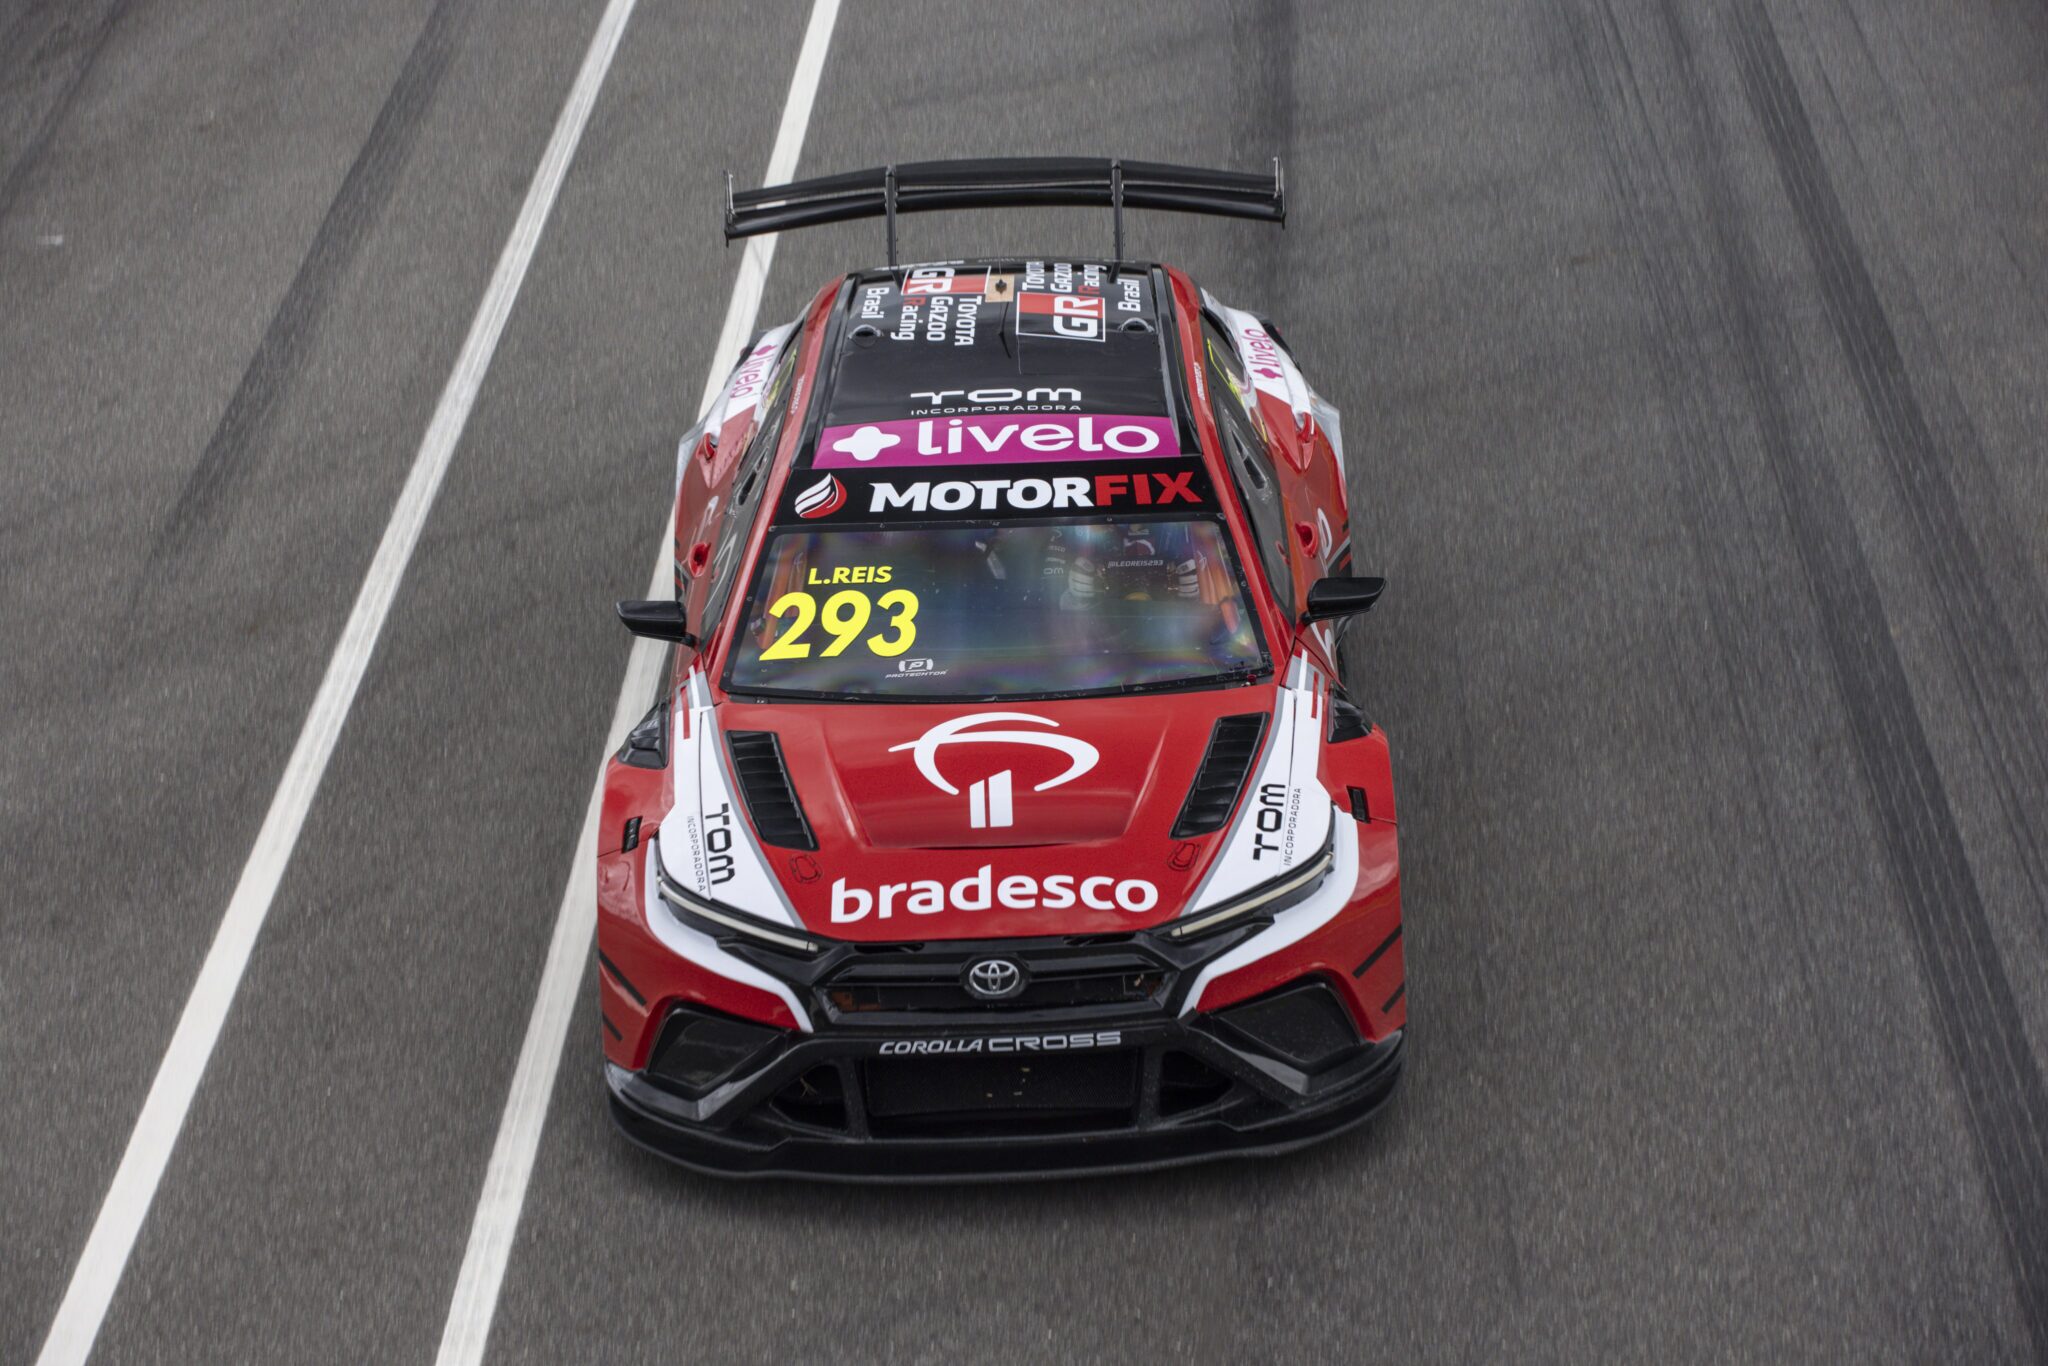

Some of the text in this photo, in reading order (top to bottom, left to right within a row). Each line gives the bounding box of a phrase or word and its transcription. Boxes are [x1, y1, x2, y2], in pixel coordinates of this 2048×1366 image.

[907, 267, 955, 295] GR
[1022, 261, 1045, 291] TOYOTA
[1050, 262, 1073, 293] GAZOO
[1078, 263, 1107, 296] Racing
[1117, 278, 1141, 313] Brasil
[861, 287, 890, 319] Brasil
[890, 297, 927, 341] Racing
[926, 296, 954, 342] GAZOO
[954, 295, 983, 346] TOYOTA
[1052, 295, 1099, 339] GR
[1242, 327, 1282, 368] livelo
[730, 353, 775, 399] livelo
[910, 387, 1082, 402] TOM
[910, 404, 1082, 415] INCORPORADORA
[916, 416, 1160, 456] livelo
[869, 471, 1202, 513] MOTORFIX
[808, 565, 892, 585] L.REIS
[759, 589, 919, 661] 293
[1252, 783, 1286, 861] TOM
[1283, 787, 1302, 867] INCORPORADORA
[686, 815, 706, 893] INCORPORADORA
[704, 802, 736, 886] TOM
[830, 864, 1159, 923] bradesco
[879, 1030, 1122, 1055] COROLLA CROSS
